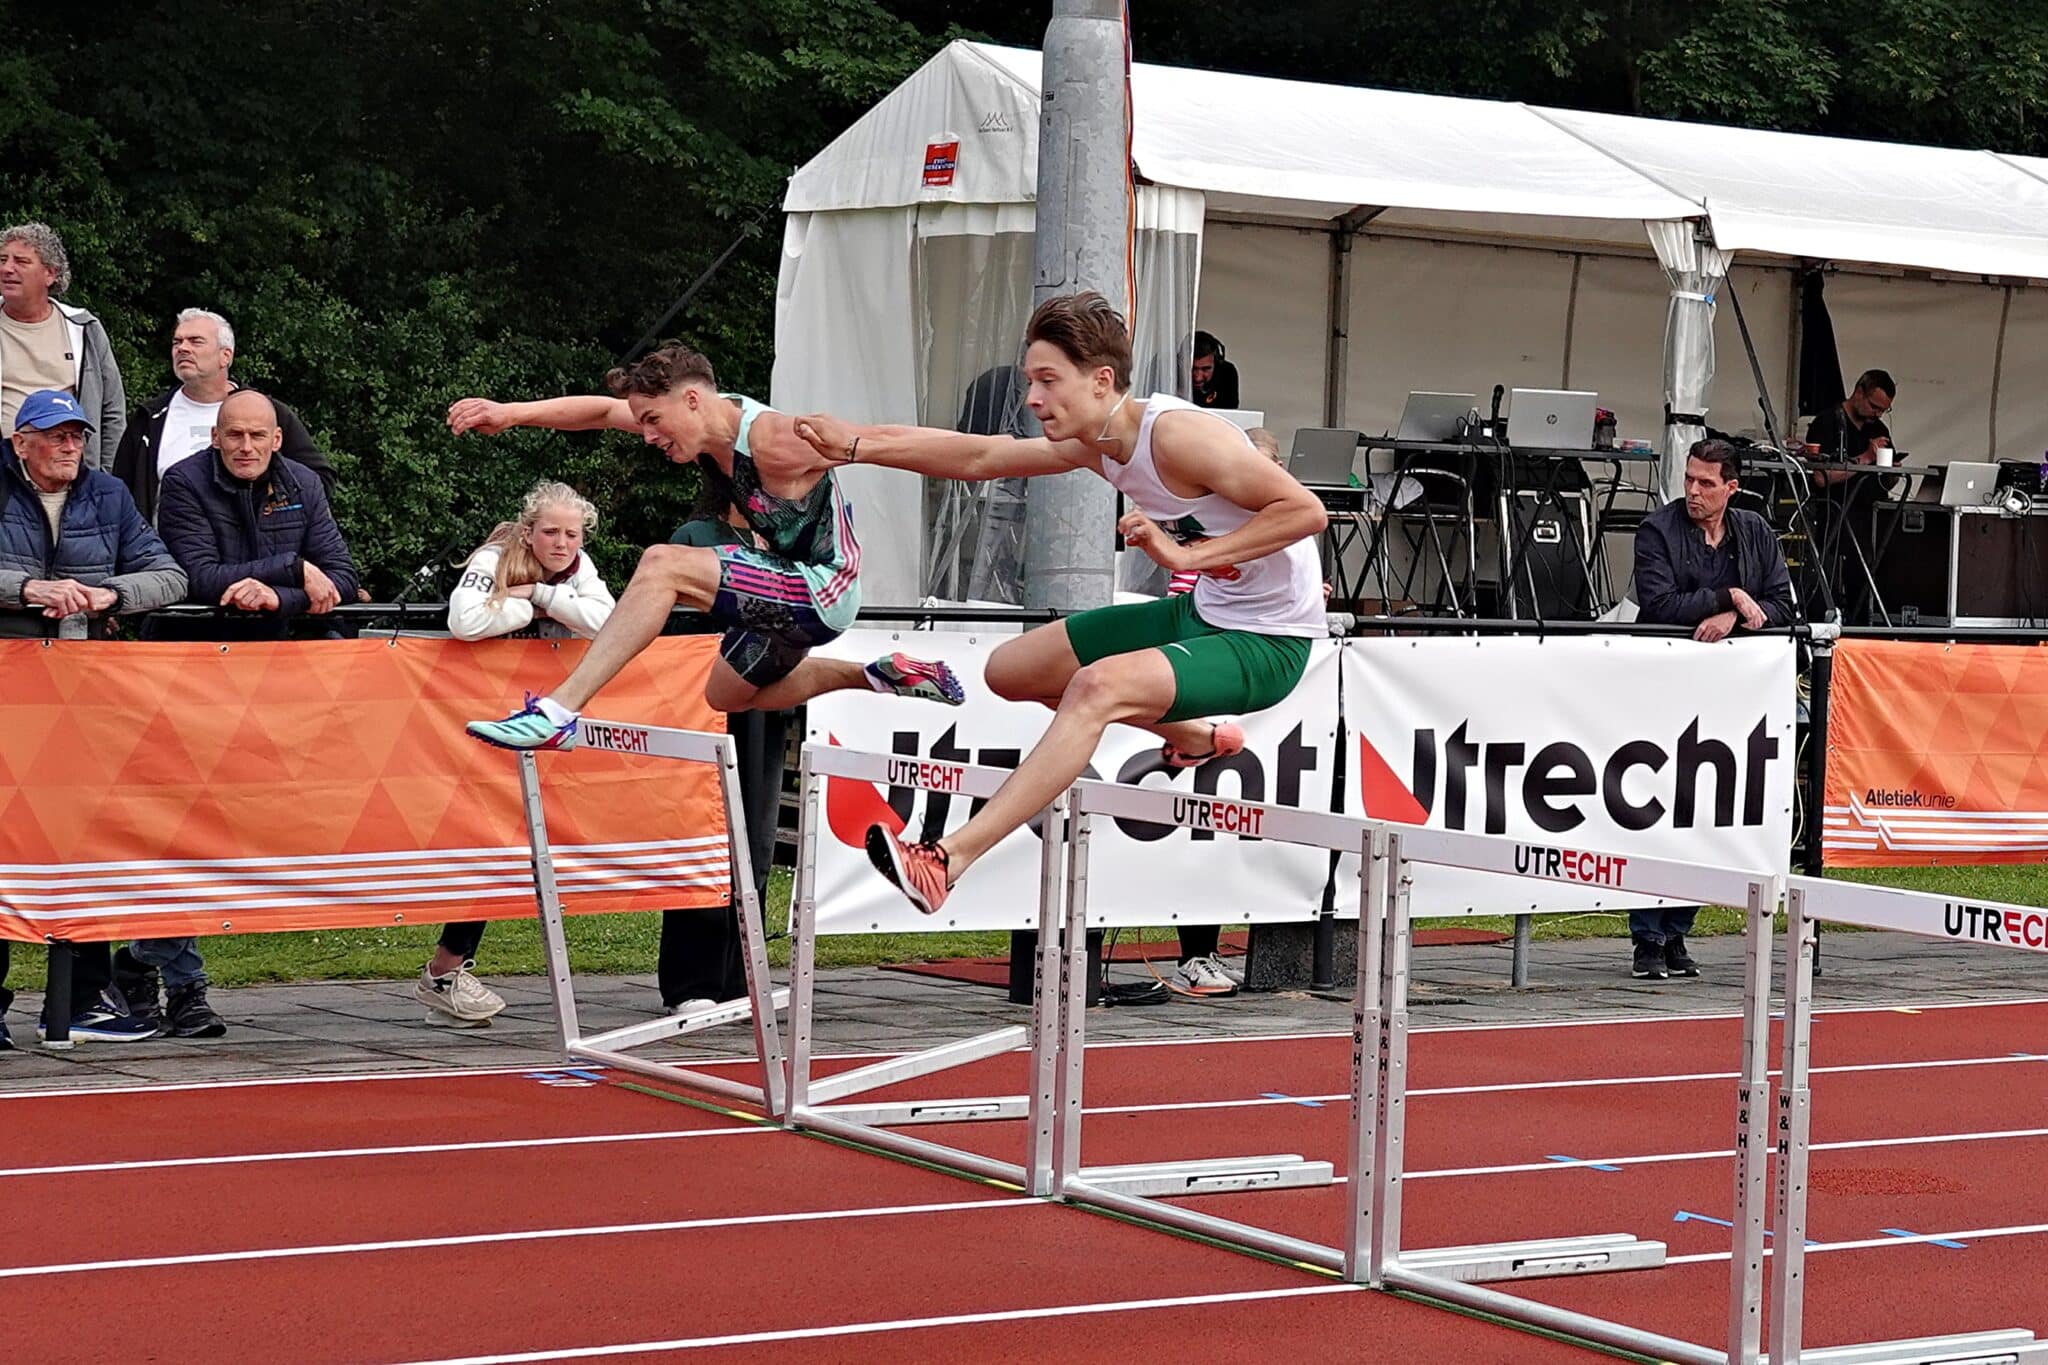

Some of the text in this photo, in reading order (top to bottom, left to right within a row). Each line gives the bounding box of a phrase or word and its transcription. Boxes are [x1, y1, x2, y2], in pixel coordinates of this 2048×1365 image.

[585, 725, 648, 752] UTRECHT
[826, 720, 1318, 850] Utcht
[888, 759, 964, 791] UTRECHT
[1359, 712, 1779, 835] Utrecht
[1173, 796, 1265, 835] UTRECHT
[1864, 788, 1956, 808] Atletiekunie
[1514, 844, 1628, 886] UTRECHT
[1944, 903, 2048, 948] UTREC
